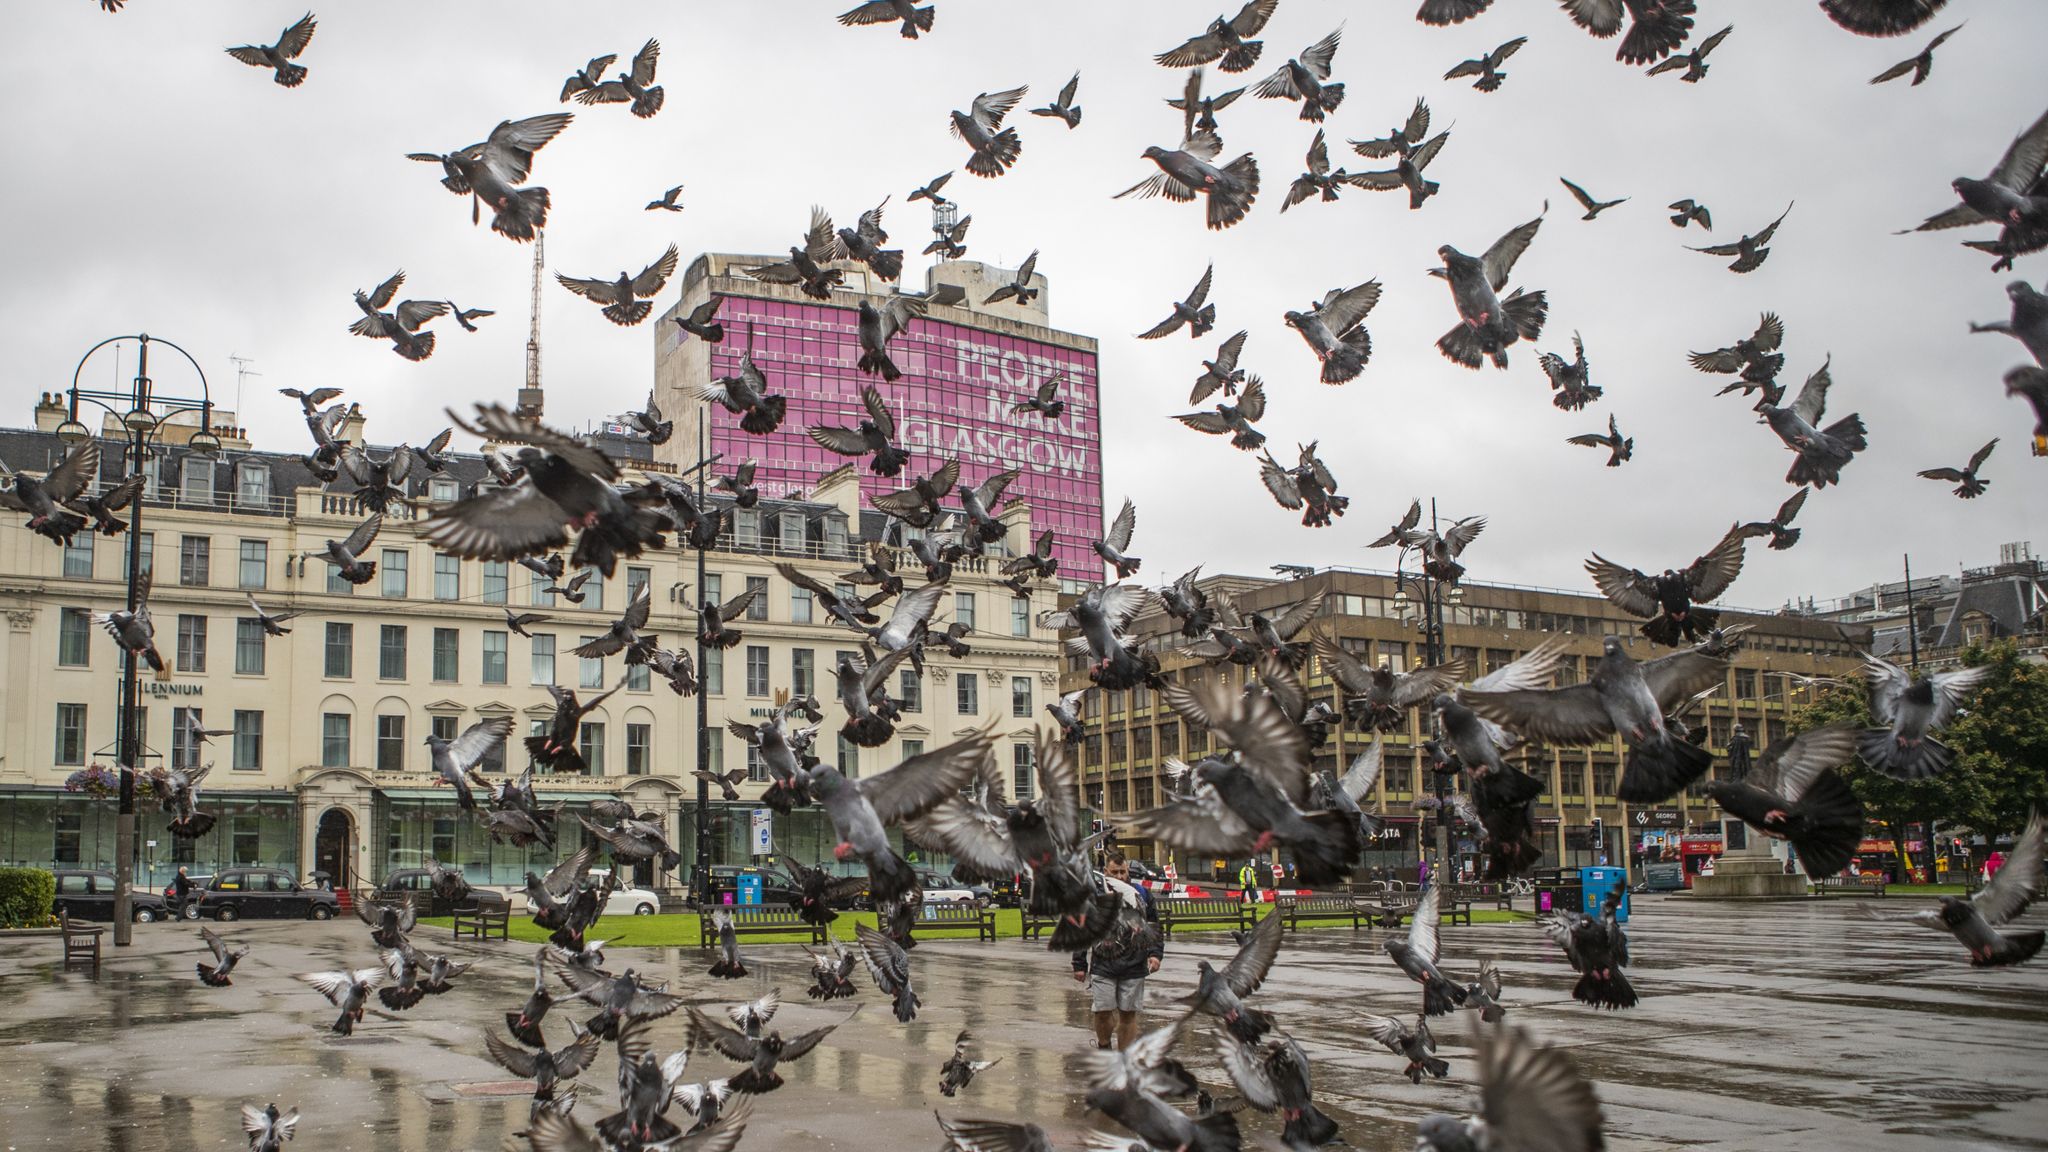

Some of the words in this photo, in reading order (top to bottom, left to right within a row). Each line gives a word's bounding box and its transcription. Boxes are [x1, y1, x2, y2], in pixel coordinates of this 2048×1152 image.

[957, 340, 1087, 399] PEOPLE
[898, 415, 1087, 478] GLASGOW
[122, 682, 203, 696] LENNIUM
